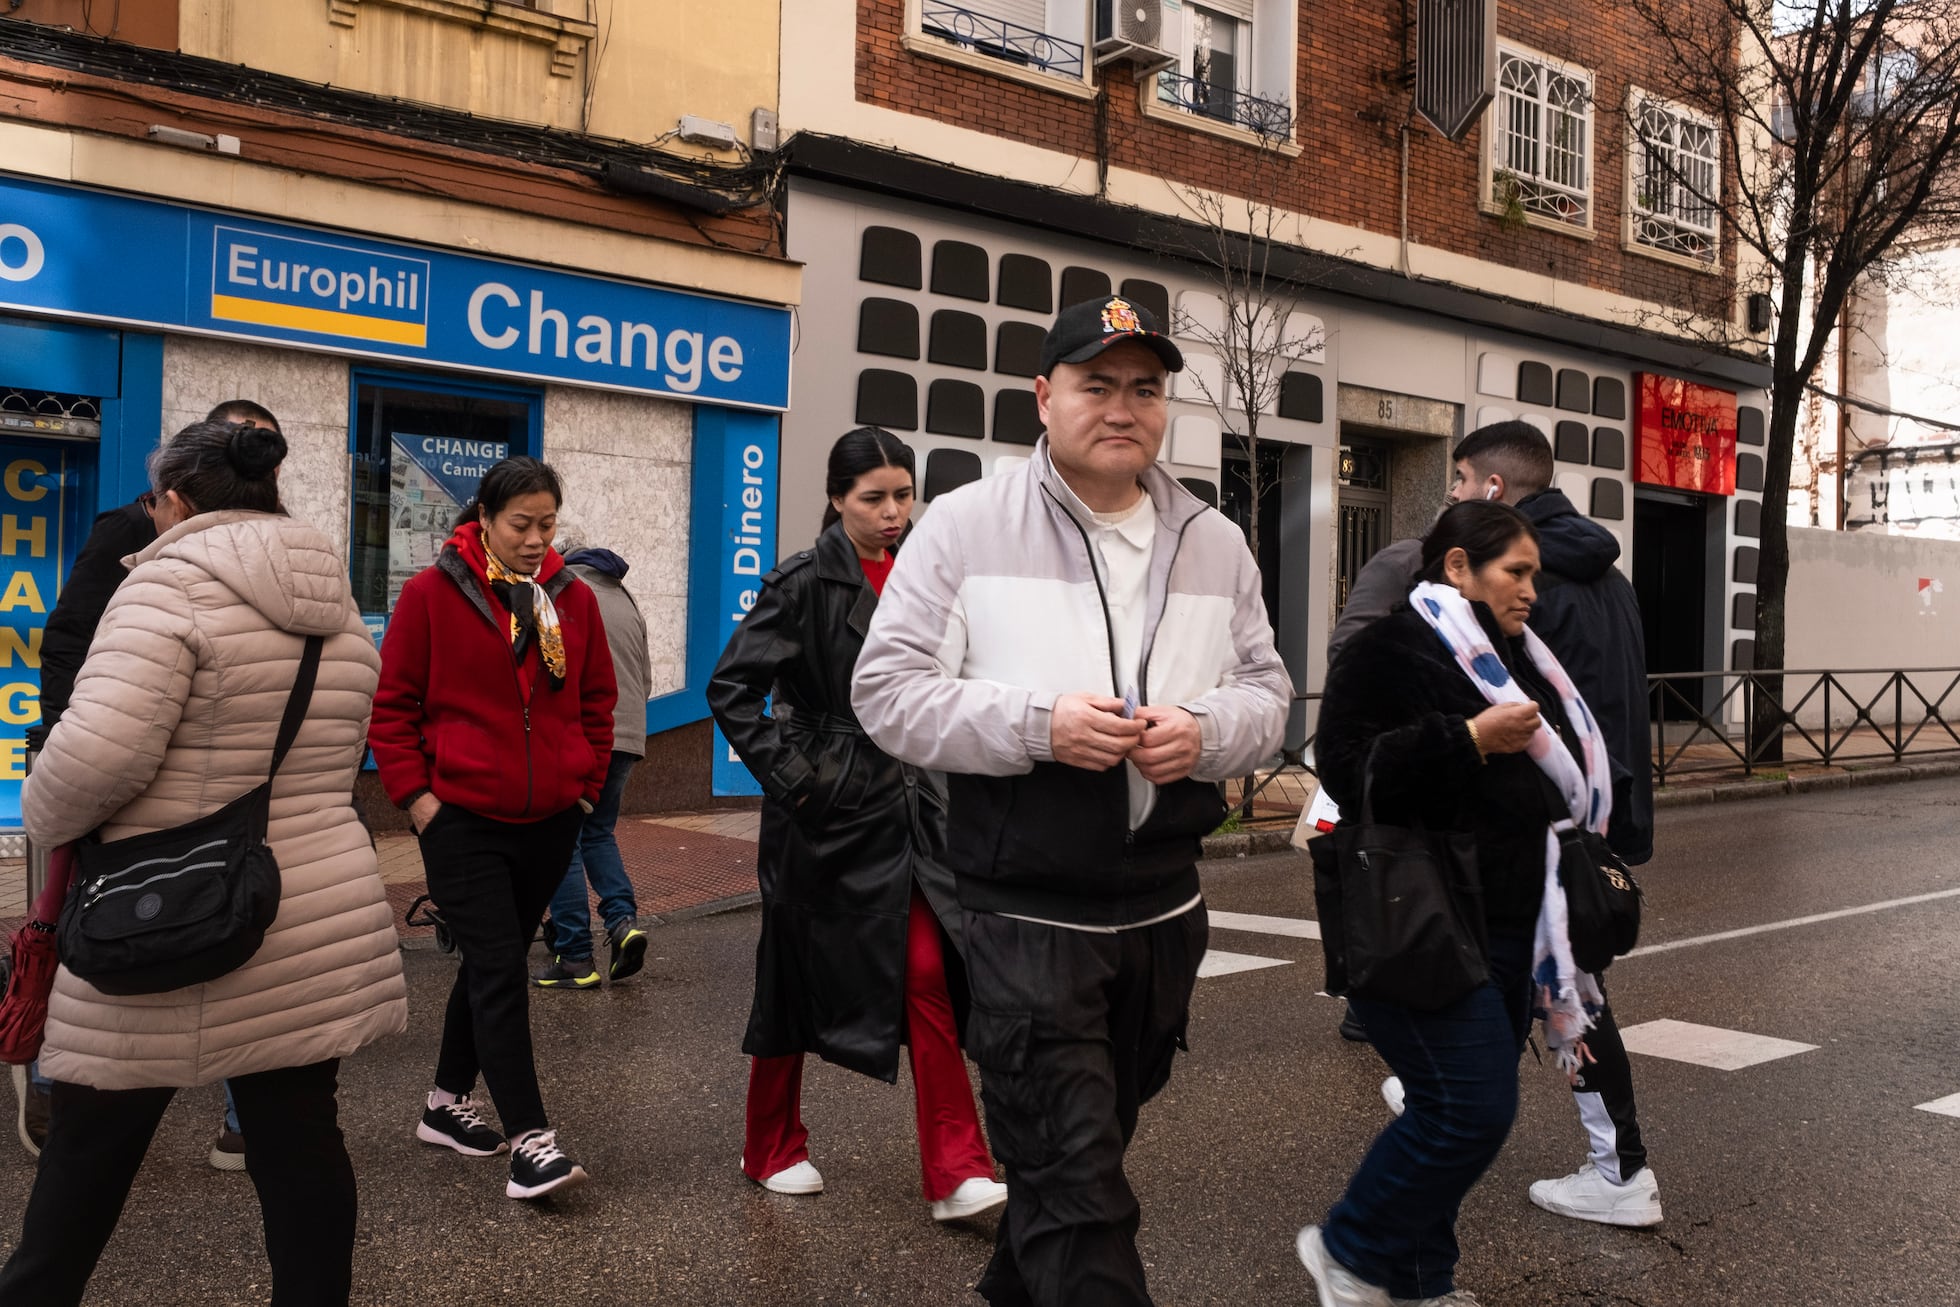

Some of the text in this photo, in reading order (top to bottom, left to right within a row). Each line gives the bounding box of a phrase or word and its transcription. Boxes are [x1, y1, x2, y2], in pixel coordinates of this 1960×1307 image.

[228, 243, 418, 311] Europhil
[467, 282, 744, 393] Change
[1378, 400, 1393, 419] 85
[1662, 408, 1719, 437] EMOTIVA
[422, 438, 505, 459] CHANGE
[442, 461, 493, 478] Camb
[1342, 459, 1353, 473] 85
[733, 444, 764, 576] Dinero
